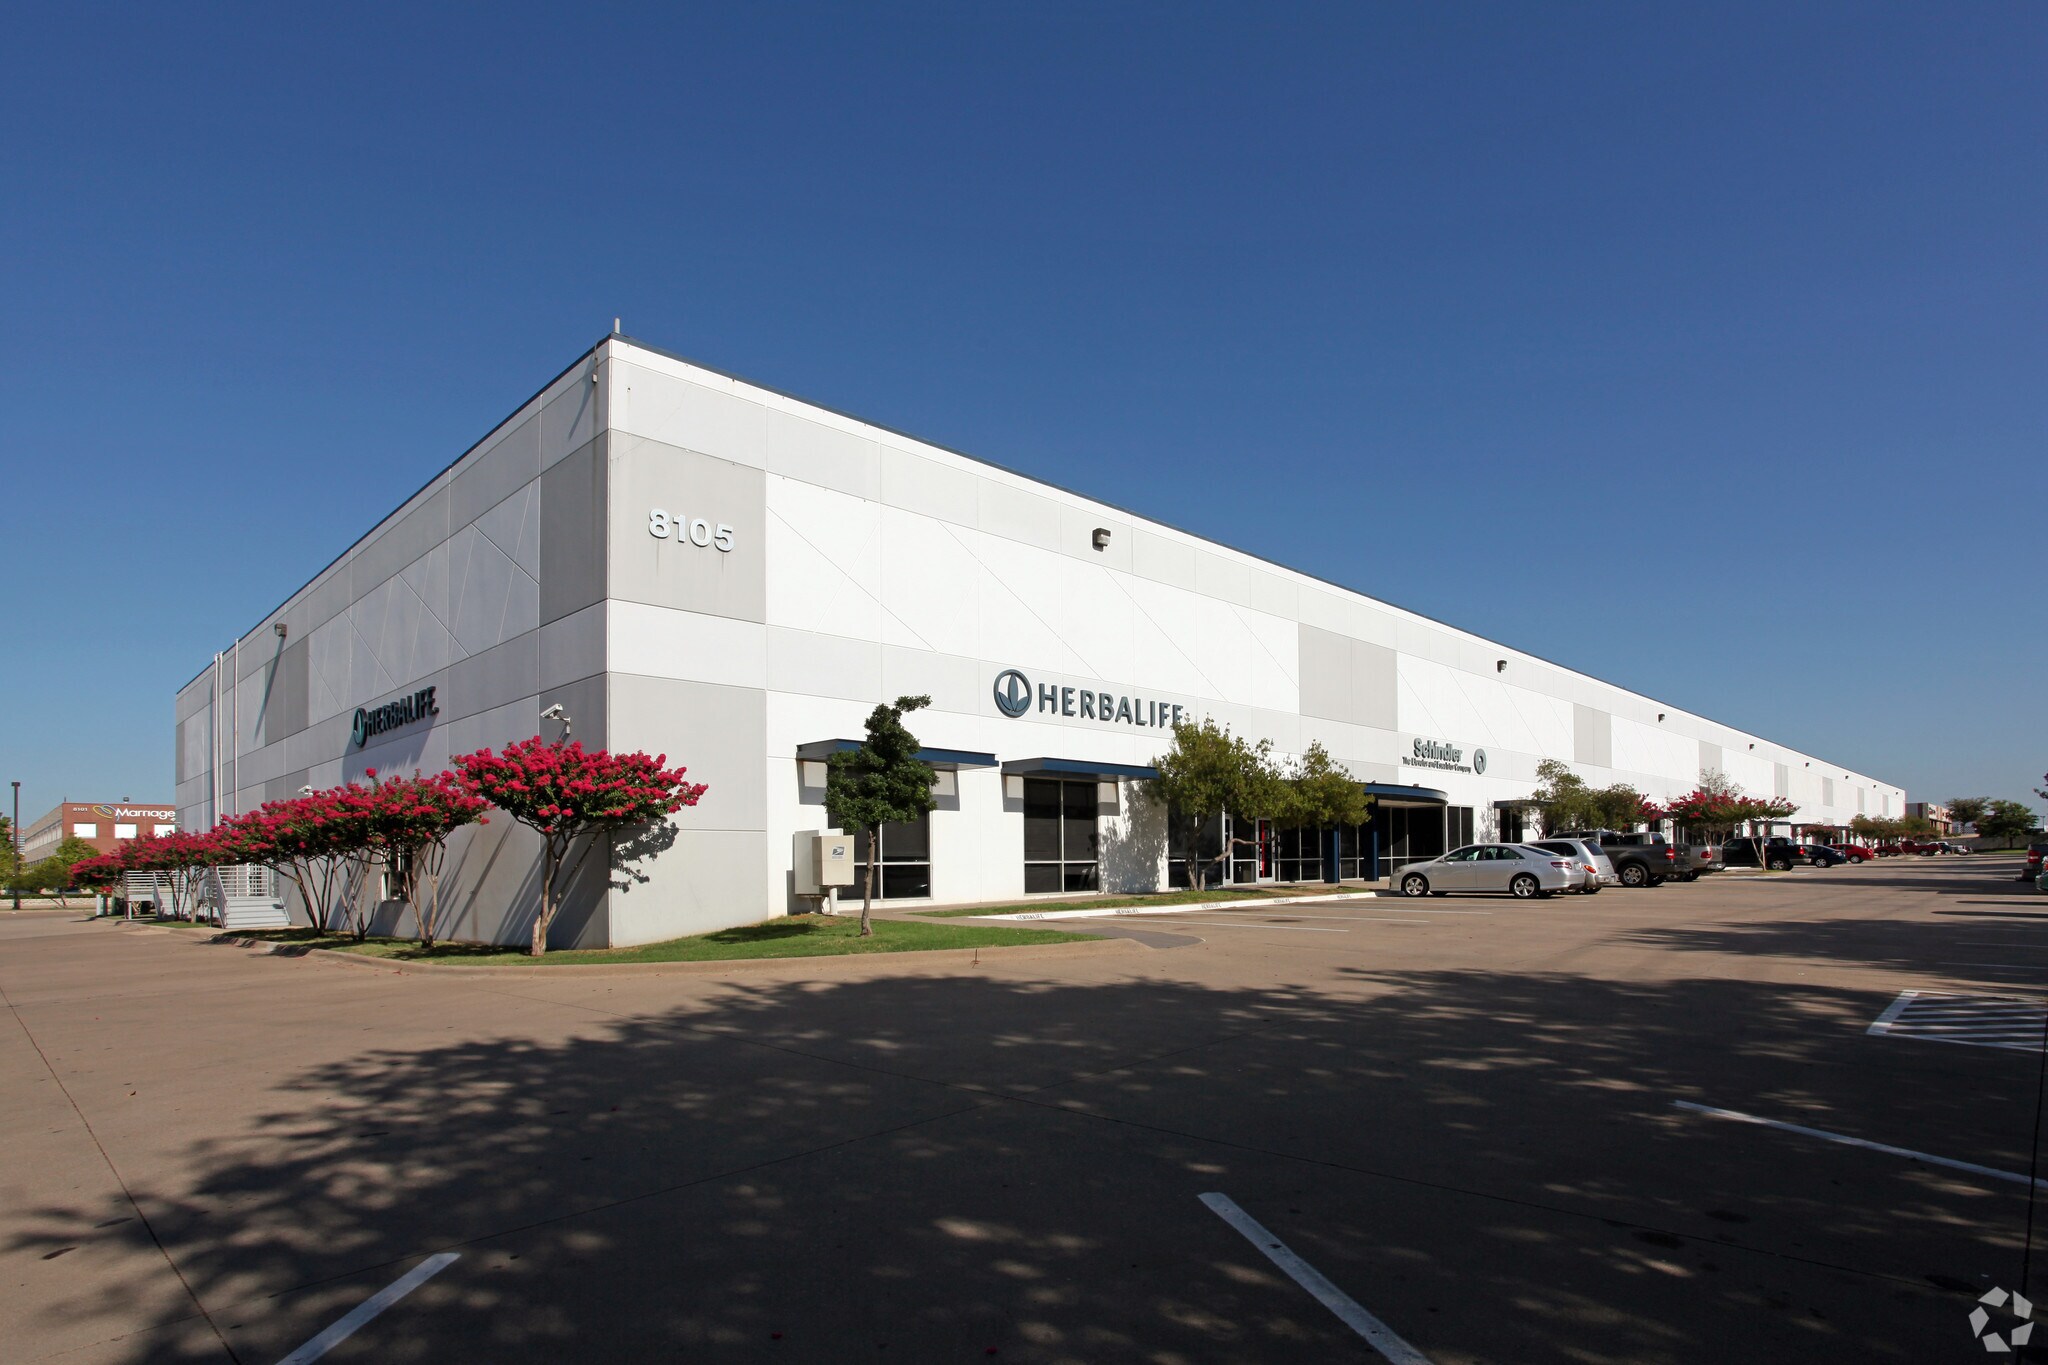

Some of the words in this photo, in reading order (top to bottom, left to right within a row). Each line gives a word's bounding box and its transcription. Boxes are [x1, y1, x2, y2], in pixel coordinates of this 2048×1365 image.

[648, 508, 735, 553] 8105
[1038, 682, 1184, 729] HERBALIFE
[1413, 737, 1463, 763] Schindler
[115, 807, 176, 820] Marriage
